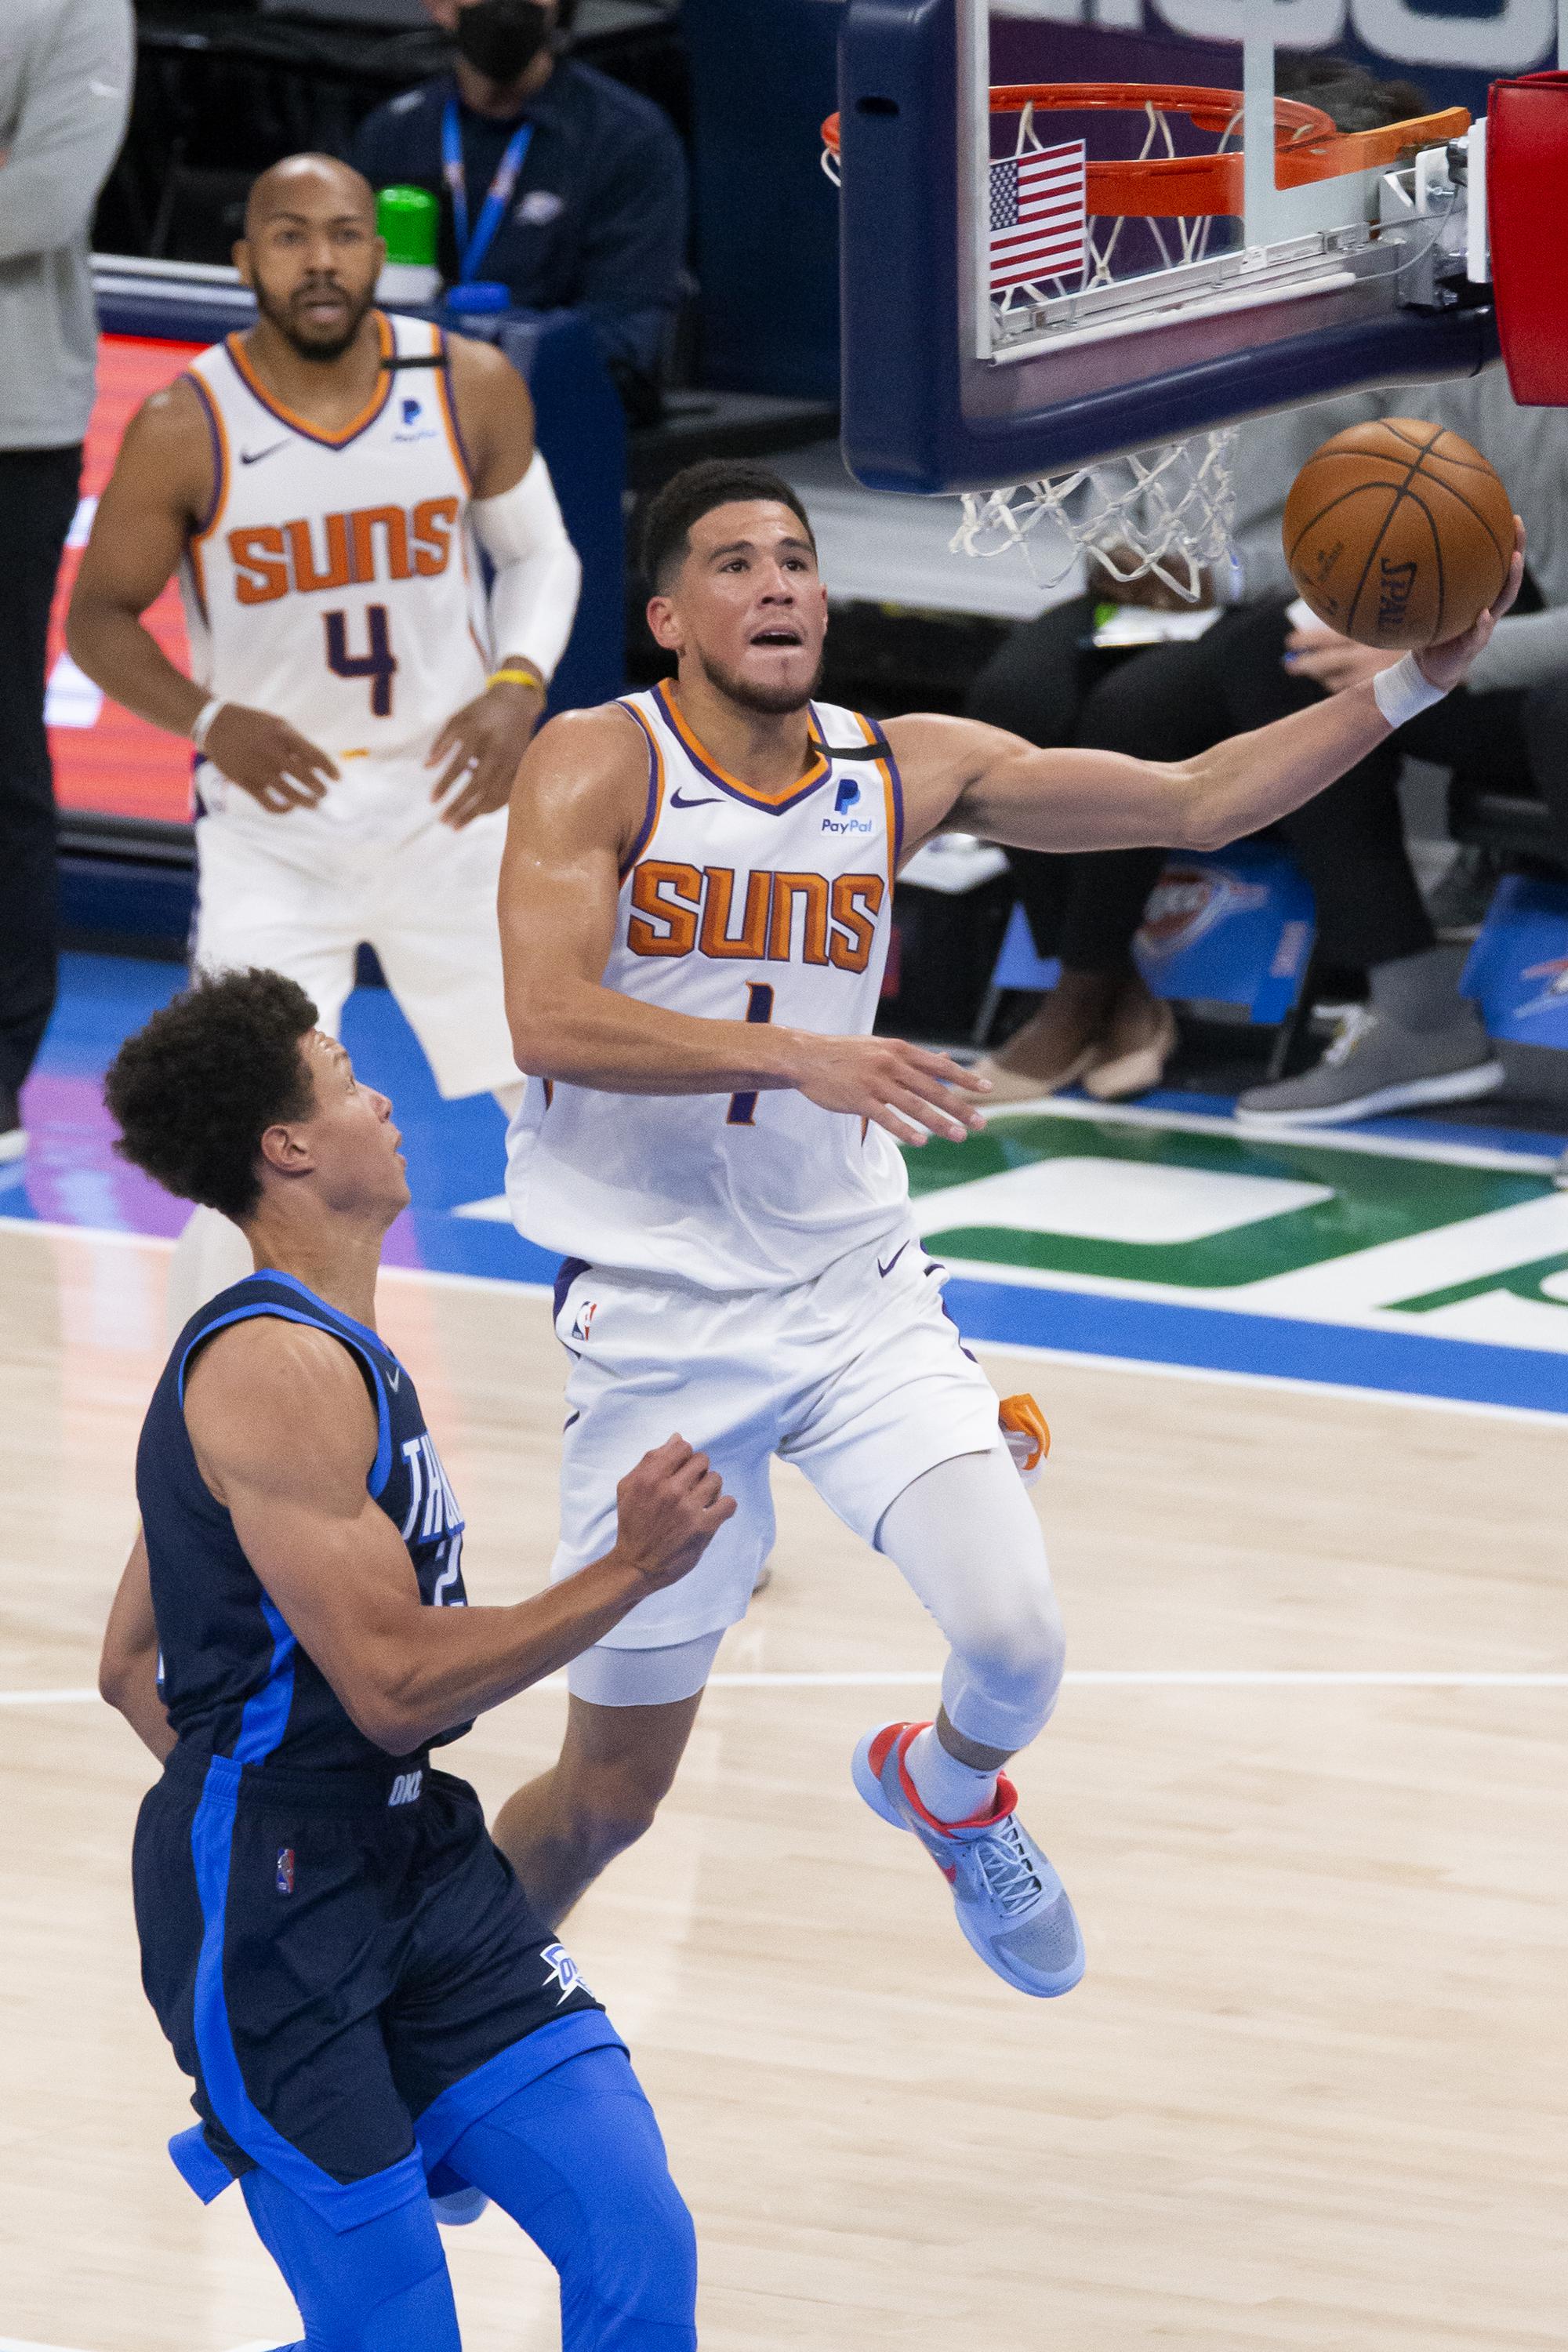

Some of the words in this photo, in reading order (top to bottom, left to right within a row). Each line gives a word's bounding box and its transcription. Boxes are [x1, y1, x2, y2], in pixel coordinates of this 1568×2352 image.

[228, 495, 459, 607] SUNS
[322, 603, 398, 718] 4
[821, 818, 873, 835] PayPal
[626, 858, 884, 975] SUNS
[725, 981, 775, 1127] 1
[388, 1769, 423, 1806] OKC
